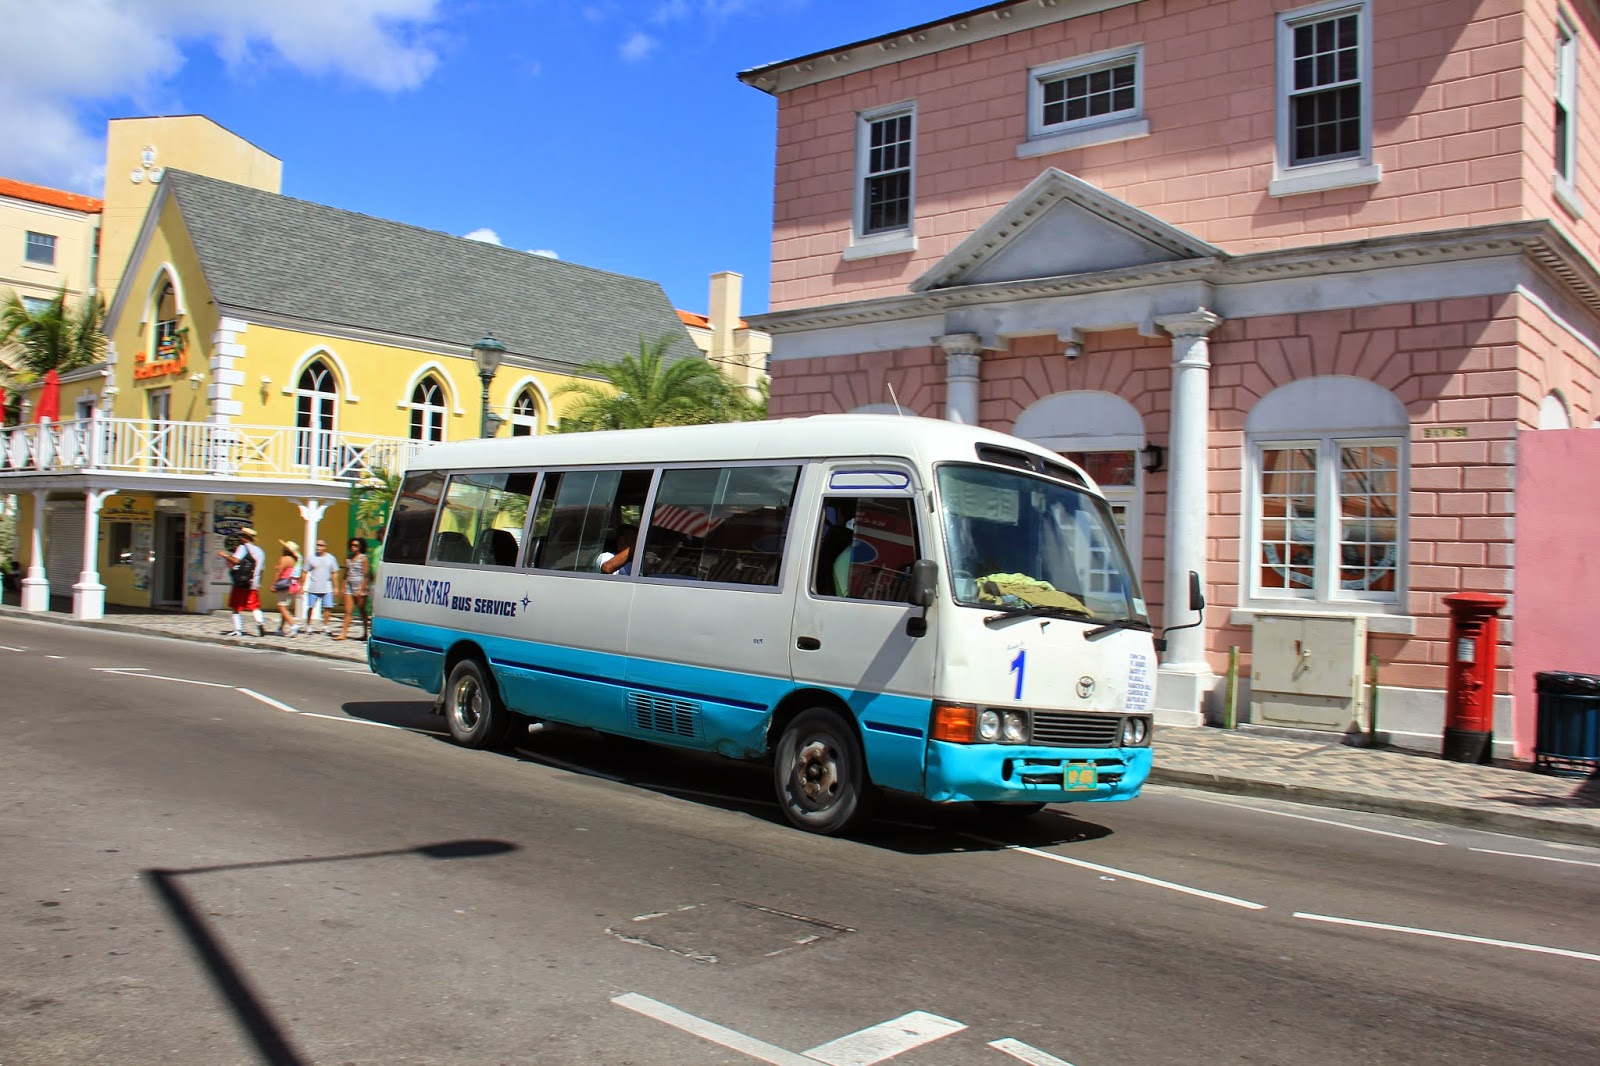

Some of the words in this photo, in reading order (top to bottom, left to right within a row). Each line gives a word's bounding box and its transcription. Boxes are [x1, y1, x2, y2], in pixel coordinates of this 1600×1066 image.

[383, 575, 424, 603] MORNING
[424, 580, 451, 608] STAR
[451, 595, 472, 612] BUS
[474, 598, 517, 618] SERVICE
[1009, 649, 1027, 700] 1
